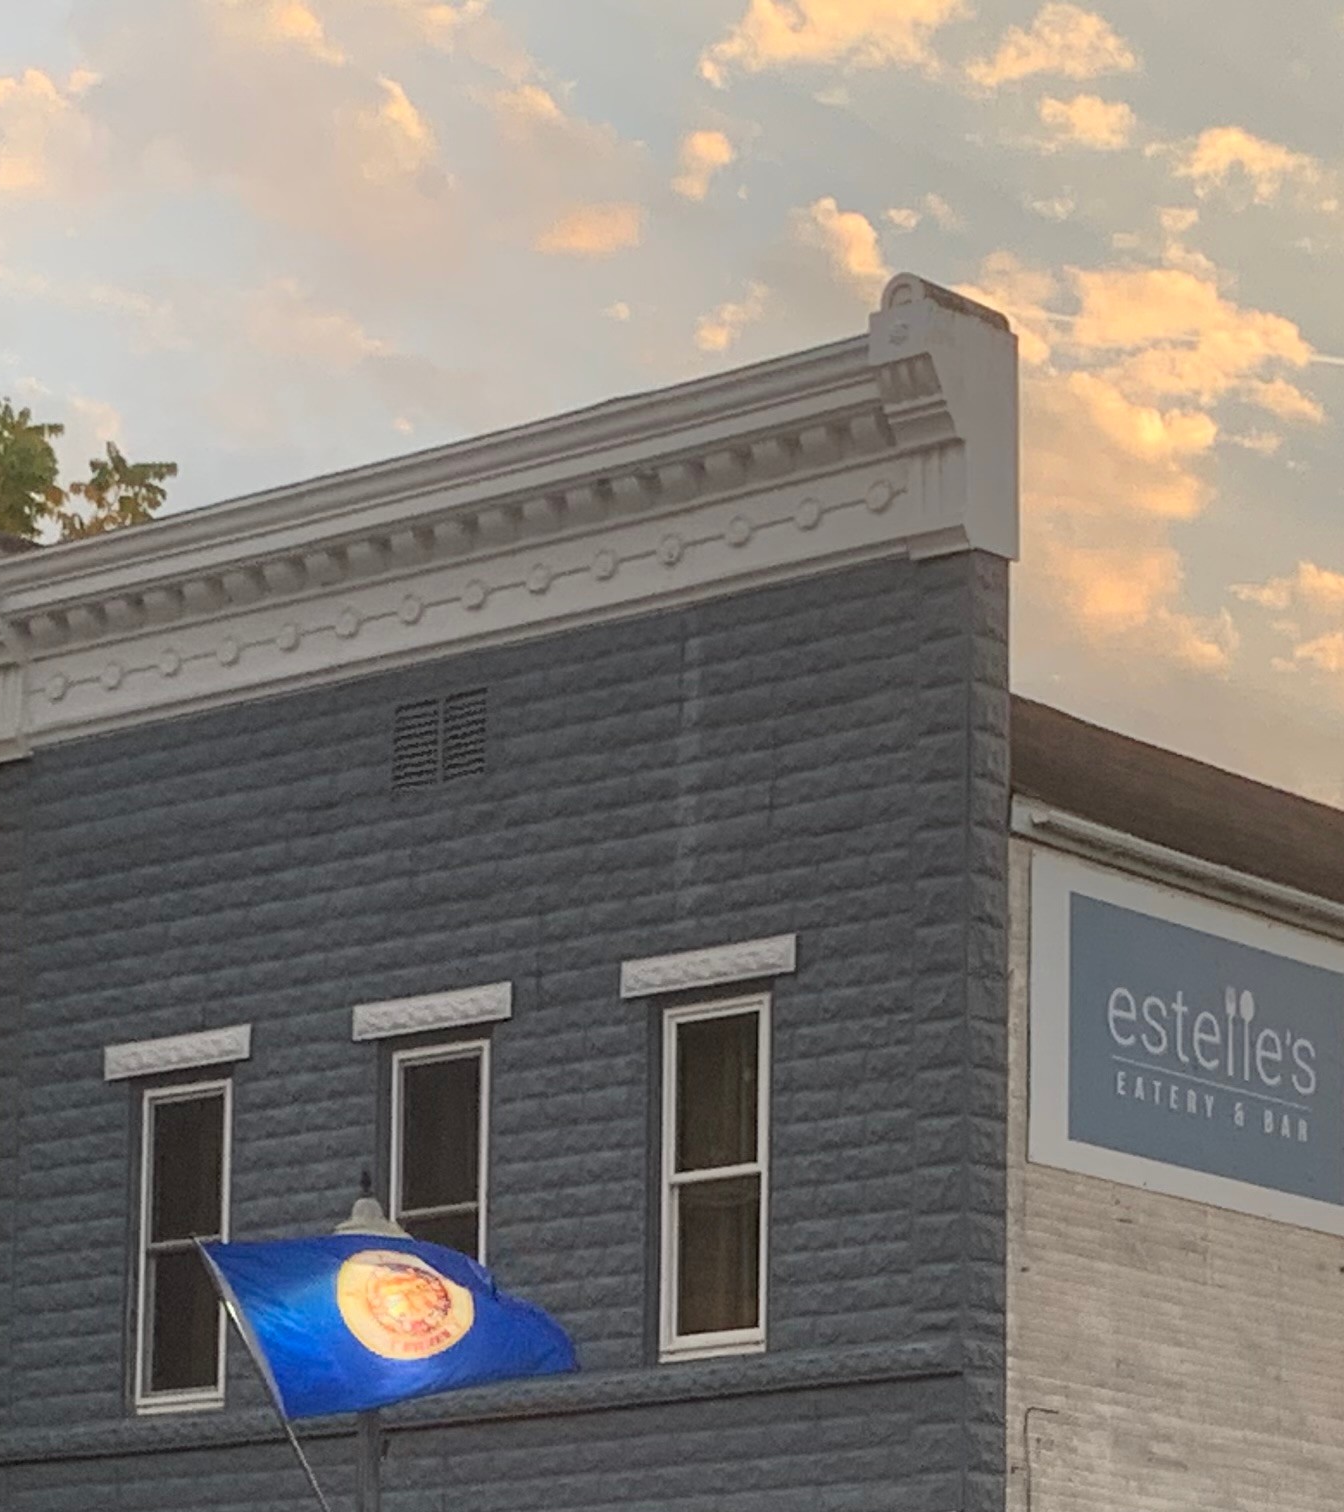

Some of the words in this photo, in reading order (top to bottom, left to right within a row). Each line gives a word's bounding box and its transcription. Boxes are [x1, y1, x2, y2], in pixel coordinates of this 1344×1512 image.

[1108, 986, 1317, 1096] estelle's
[1116, 1070, 1215, 1118] EATERY
[1234, 1103, 1245, 1128] &
[1264, 1109, 1309, 1143] BAR
